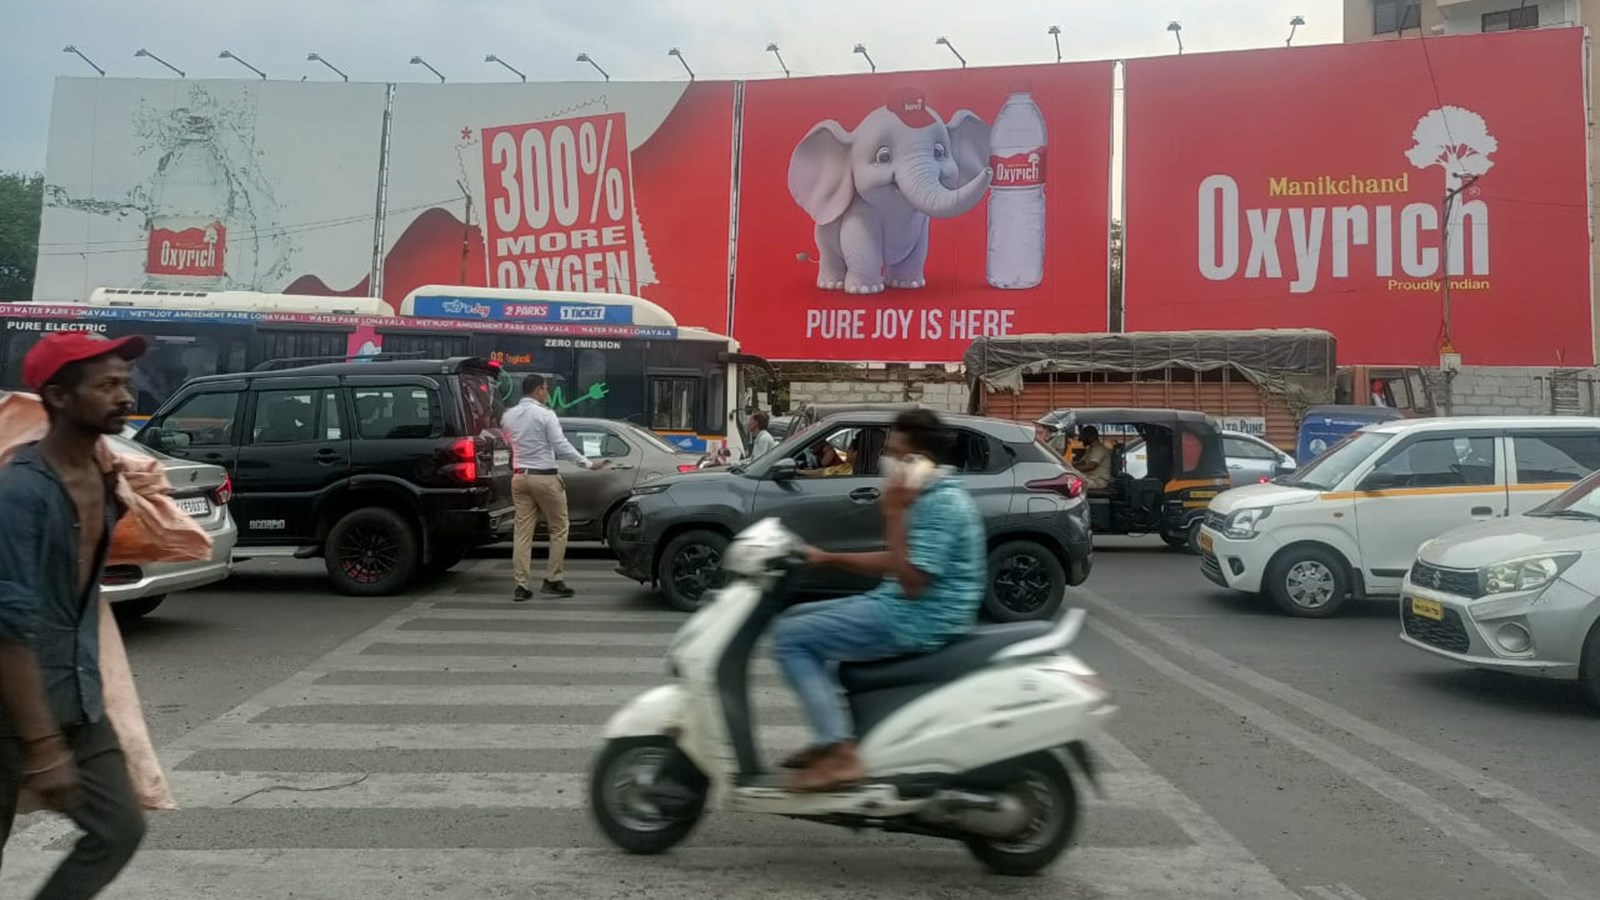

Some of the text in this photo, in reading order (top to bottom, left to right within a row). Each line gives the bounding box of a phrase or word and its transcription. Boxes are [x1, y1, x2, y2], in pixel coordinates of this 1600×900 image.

[491, 119, 625, 232] 300%
[996, 160, 1040, 183] Oxyrich
[1269, 173, 1409, 197] Manikchand
[496, 226, 627, 256] MORE
[1198, 173, 1490, 293] Oxyrich
[160, 240, 216, 270] Oxyrich
[497, 251, 630, 294] OXYGEN
[1388, 278, 1490, 293] Proudly ndian
[14, 306, 41, 314] WATER
[250, 313, 297, 321] LONAVALA
[309, 315, 337, 323] WATER
[505, 305, 548, 316] 2 PARKS
[563, 308, 603, 318] 1 TICKET
[7, 321, 108, 332] PURE ELECTRIC
[806, 309, 1015, 339] PURE JOY IS HERE
[544, 338, 621, 349] ZERO EMISSION
[249, 519, 286, 530] SCORPIO
